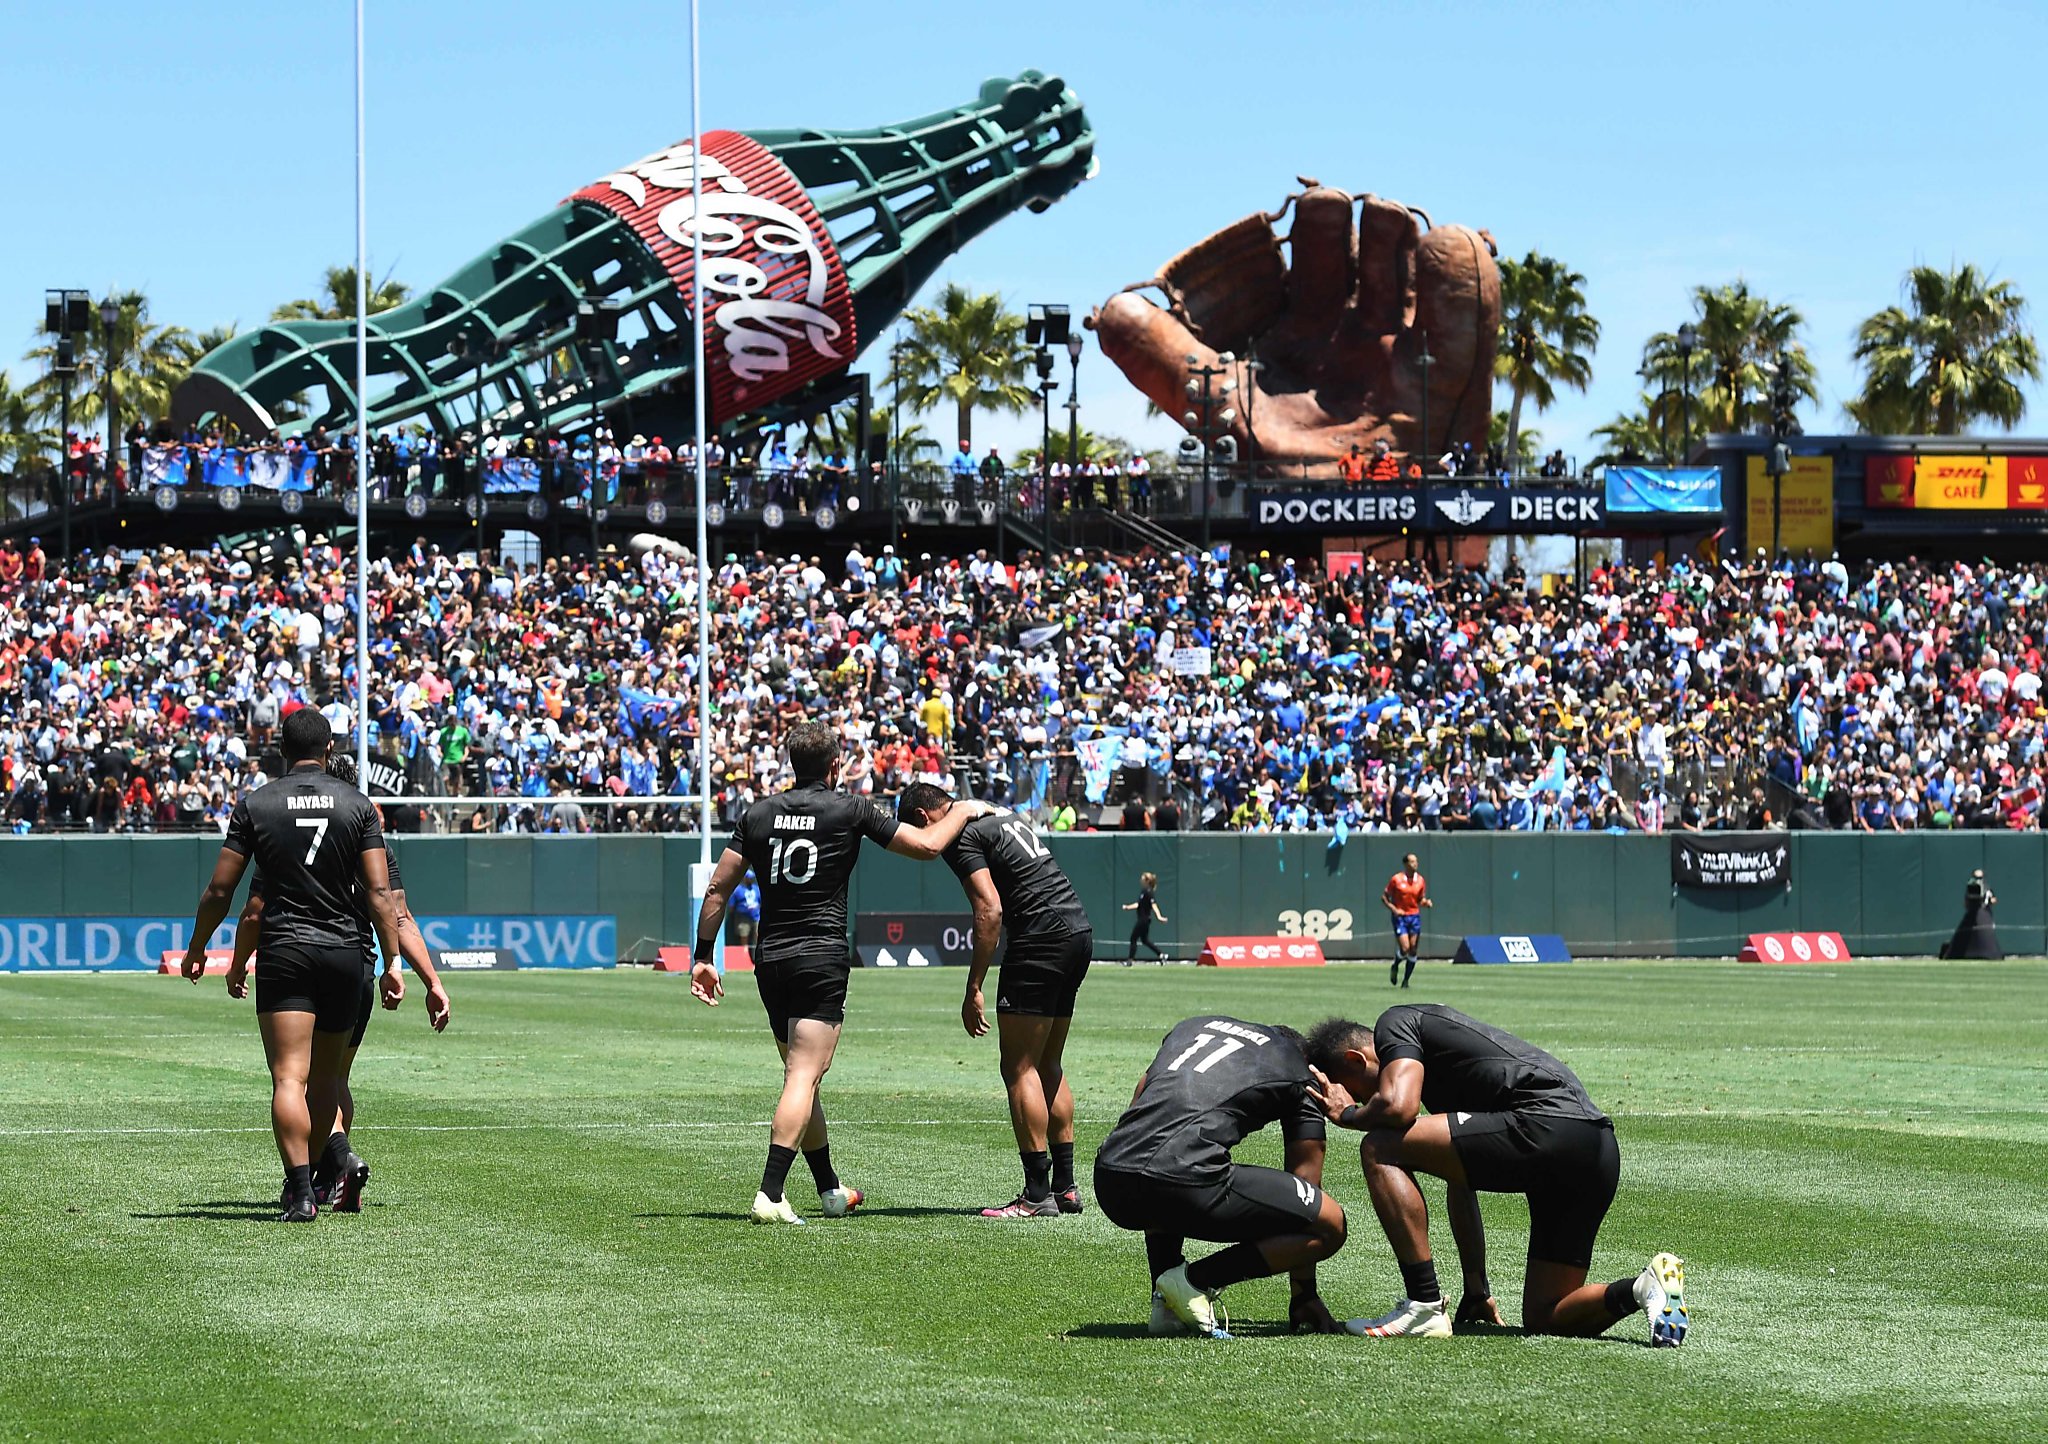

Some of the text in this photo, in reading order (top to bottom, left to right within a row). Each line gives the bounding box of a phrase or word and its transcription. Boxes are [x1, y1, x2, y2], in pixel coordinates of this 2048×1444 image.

[1937, 467, 1984, 478] DHL
[1259, 495, 1600, 524] DOCKERS DECK
[286, 795, 335, 810] RAYASI
[773, 814, 816, 831] BAKER
[295, 817, 329, 866] 7
[1001, 820, 1051, 859] 12
[768, 837, 818, 885] 10
[1724, 871, 1733, 883] IT
[1277, 908, 1354, 942] 382
[1167, 1033, 1245, 1074] 11
